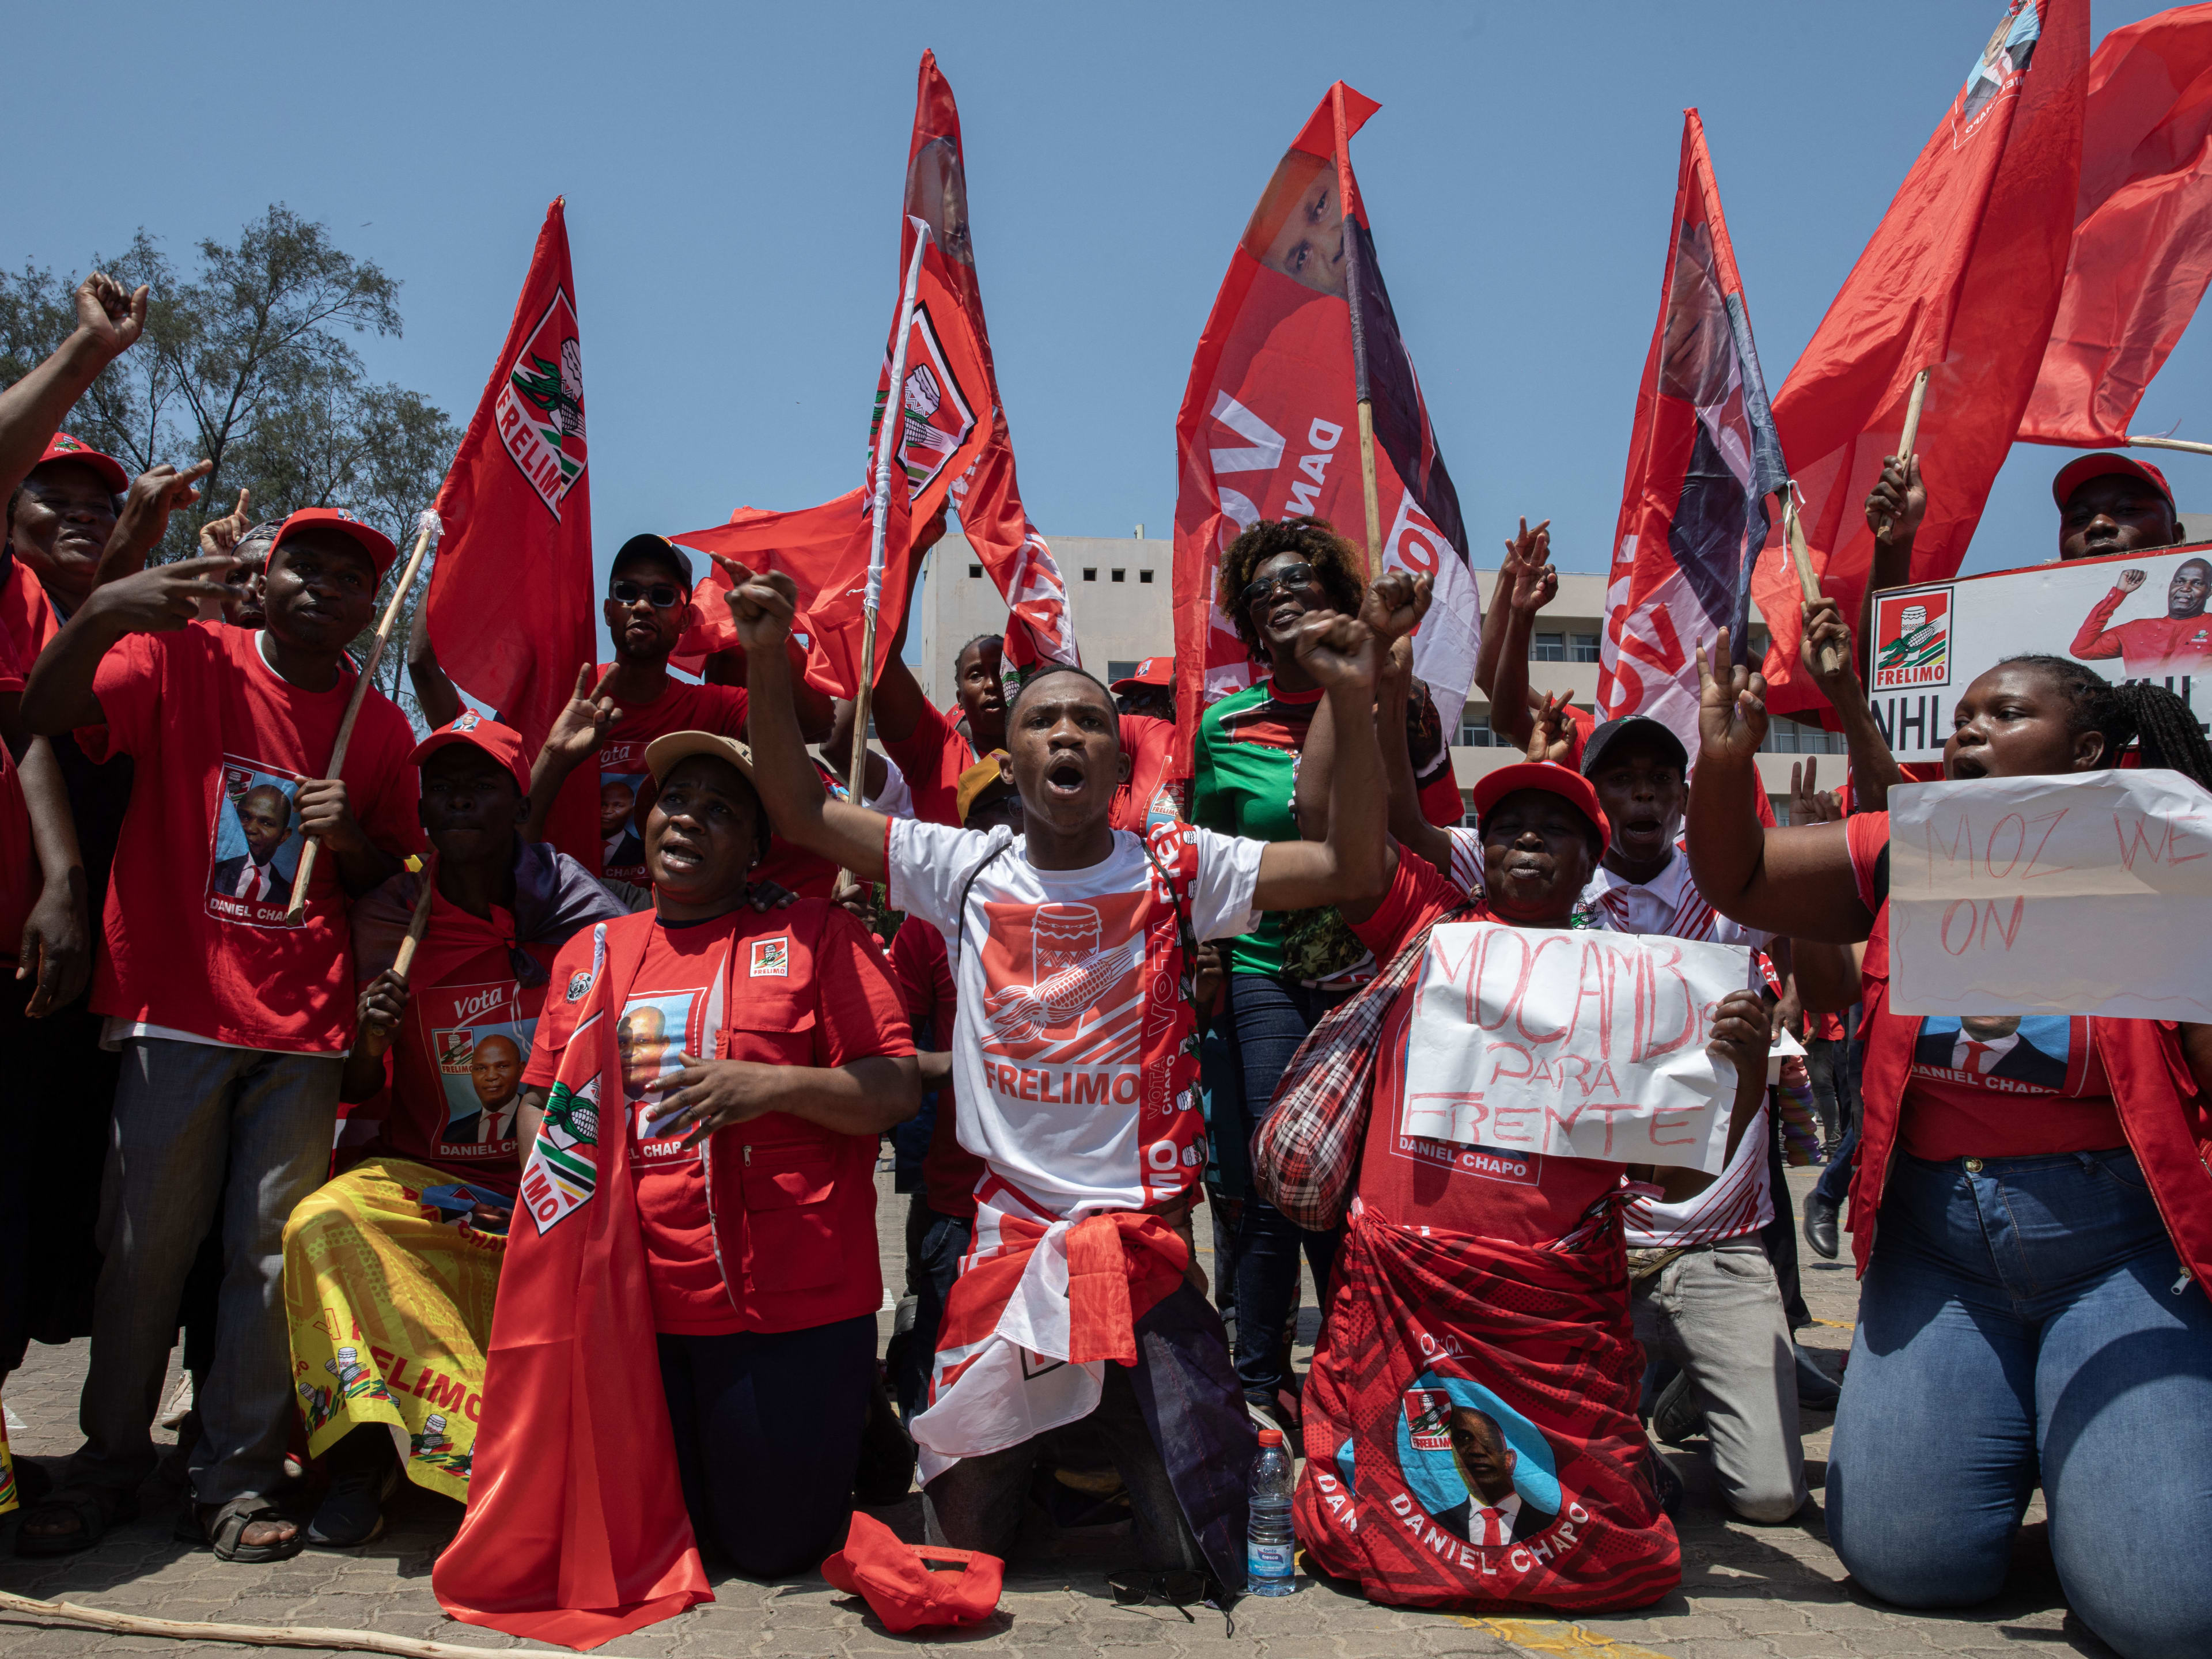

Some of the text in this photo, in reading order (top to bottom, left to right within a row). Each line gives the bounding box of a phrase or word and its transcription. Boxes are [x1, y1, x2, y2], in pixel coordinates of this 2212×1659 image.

[1877, 664, 1945, 687] FRELIMO
[605, 866, 646, 877] CHAPO
[1926, 808, 2209, 894] MOZ WE
[209, 897, 252, 918] DANIEL
[1941, 894, 2024, 956] ON
[454, 987, 502, 1018] Vota
[983, 1059, 1141, 1105] FRELIMO
[1147, 1056, 1165, 1120] VOTA
[1162, 1055, 1175, 1115] CHAPO
[1486, 1041, 1622, 1098] PARA
[441, 1144, 497, 1156] DANIEL
[1404, 1092, 1706, 1157] FRENTE
[1399, 1137, 1527, 1176] DANIEL CHAPO
[1391, 1493, 1589, 1574] DANIEL CHAPO
